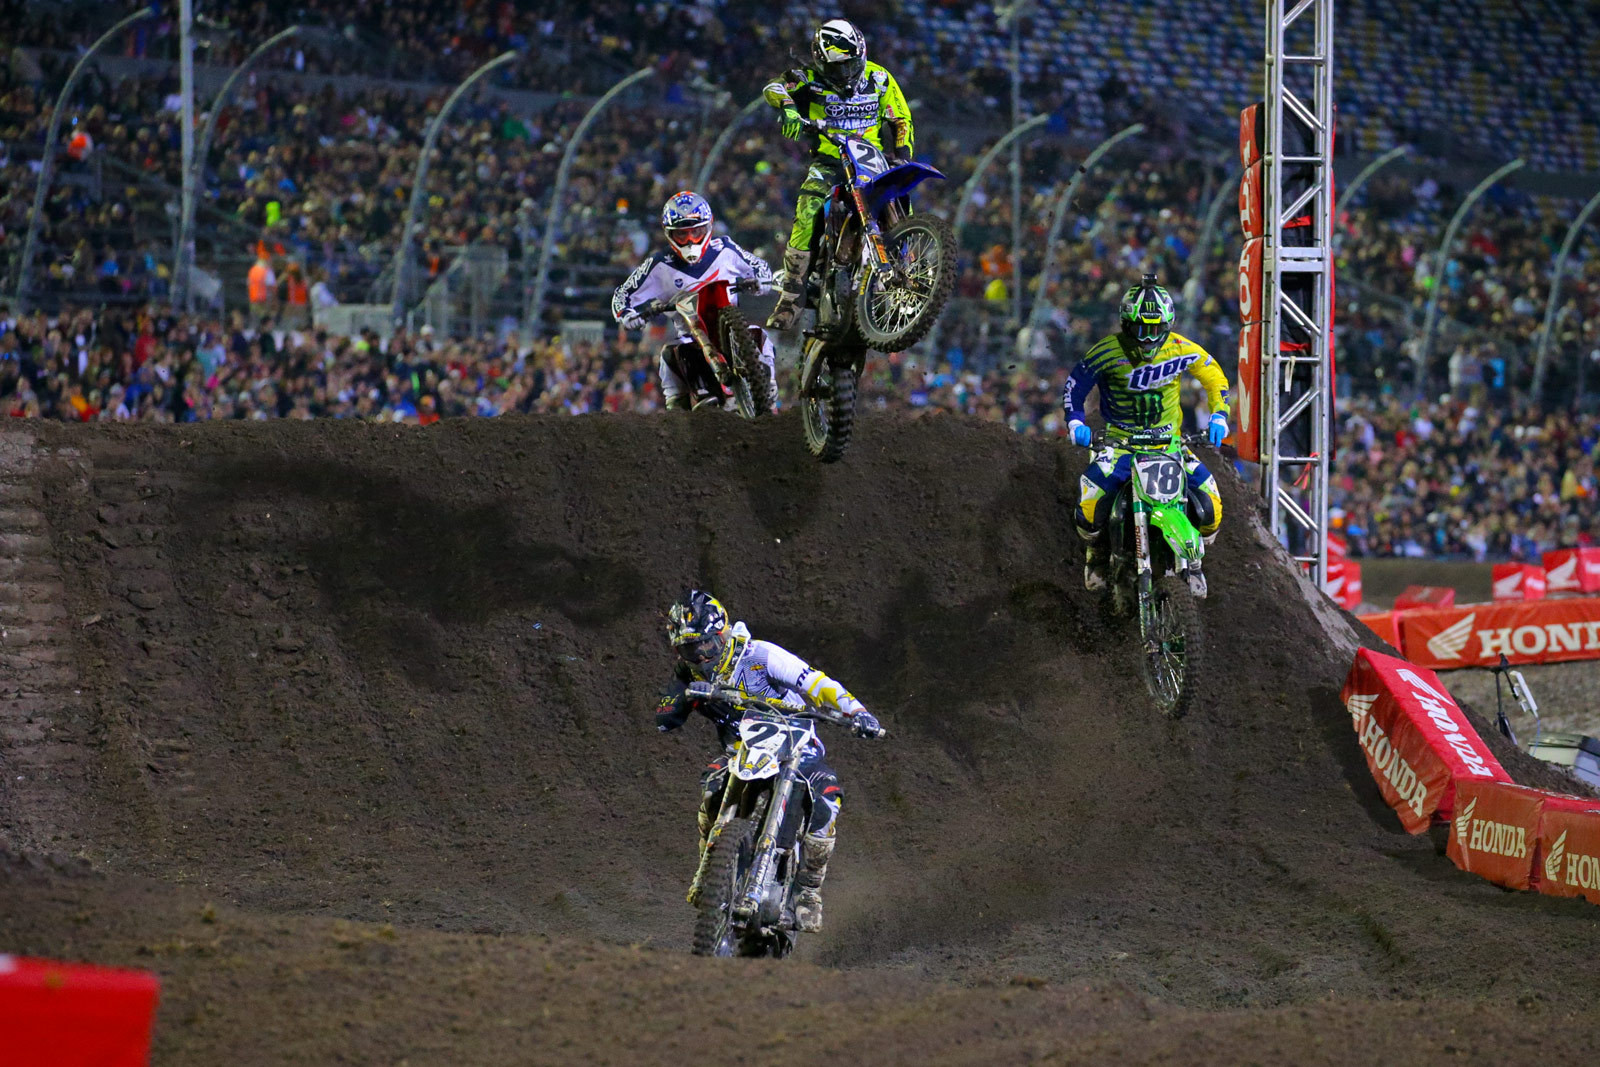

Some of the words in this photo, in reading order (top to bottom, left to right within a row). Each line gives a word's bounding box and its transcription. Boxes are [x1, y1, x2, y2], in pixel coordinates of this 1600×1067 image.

[1141, 462, 1181, 495] 18
[1411, 691, 1494, 777] HONDA
[1361, 715, 1428, 818] HONDA
[1469, 818, 1526, 859] HONDA
